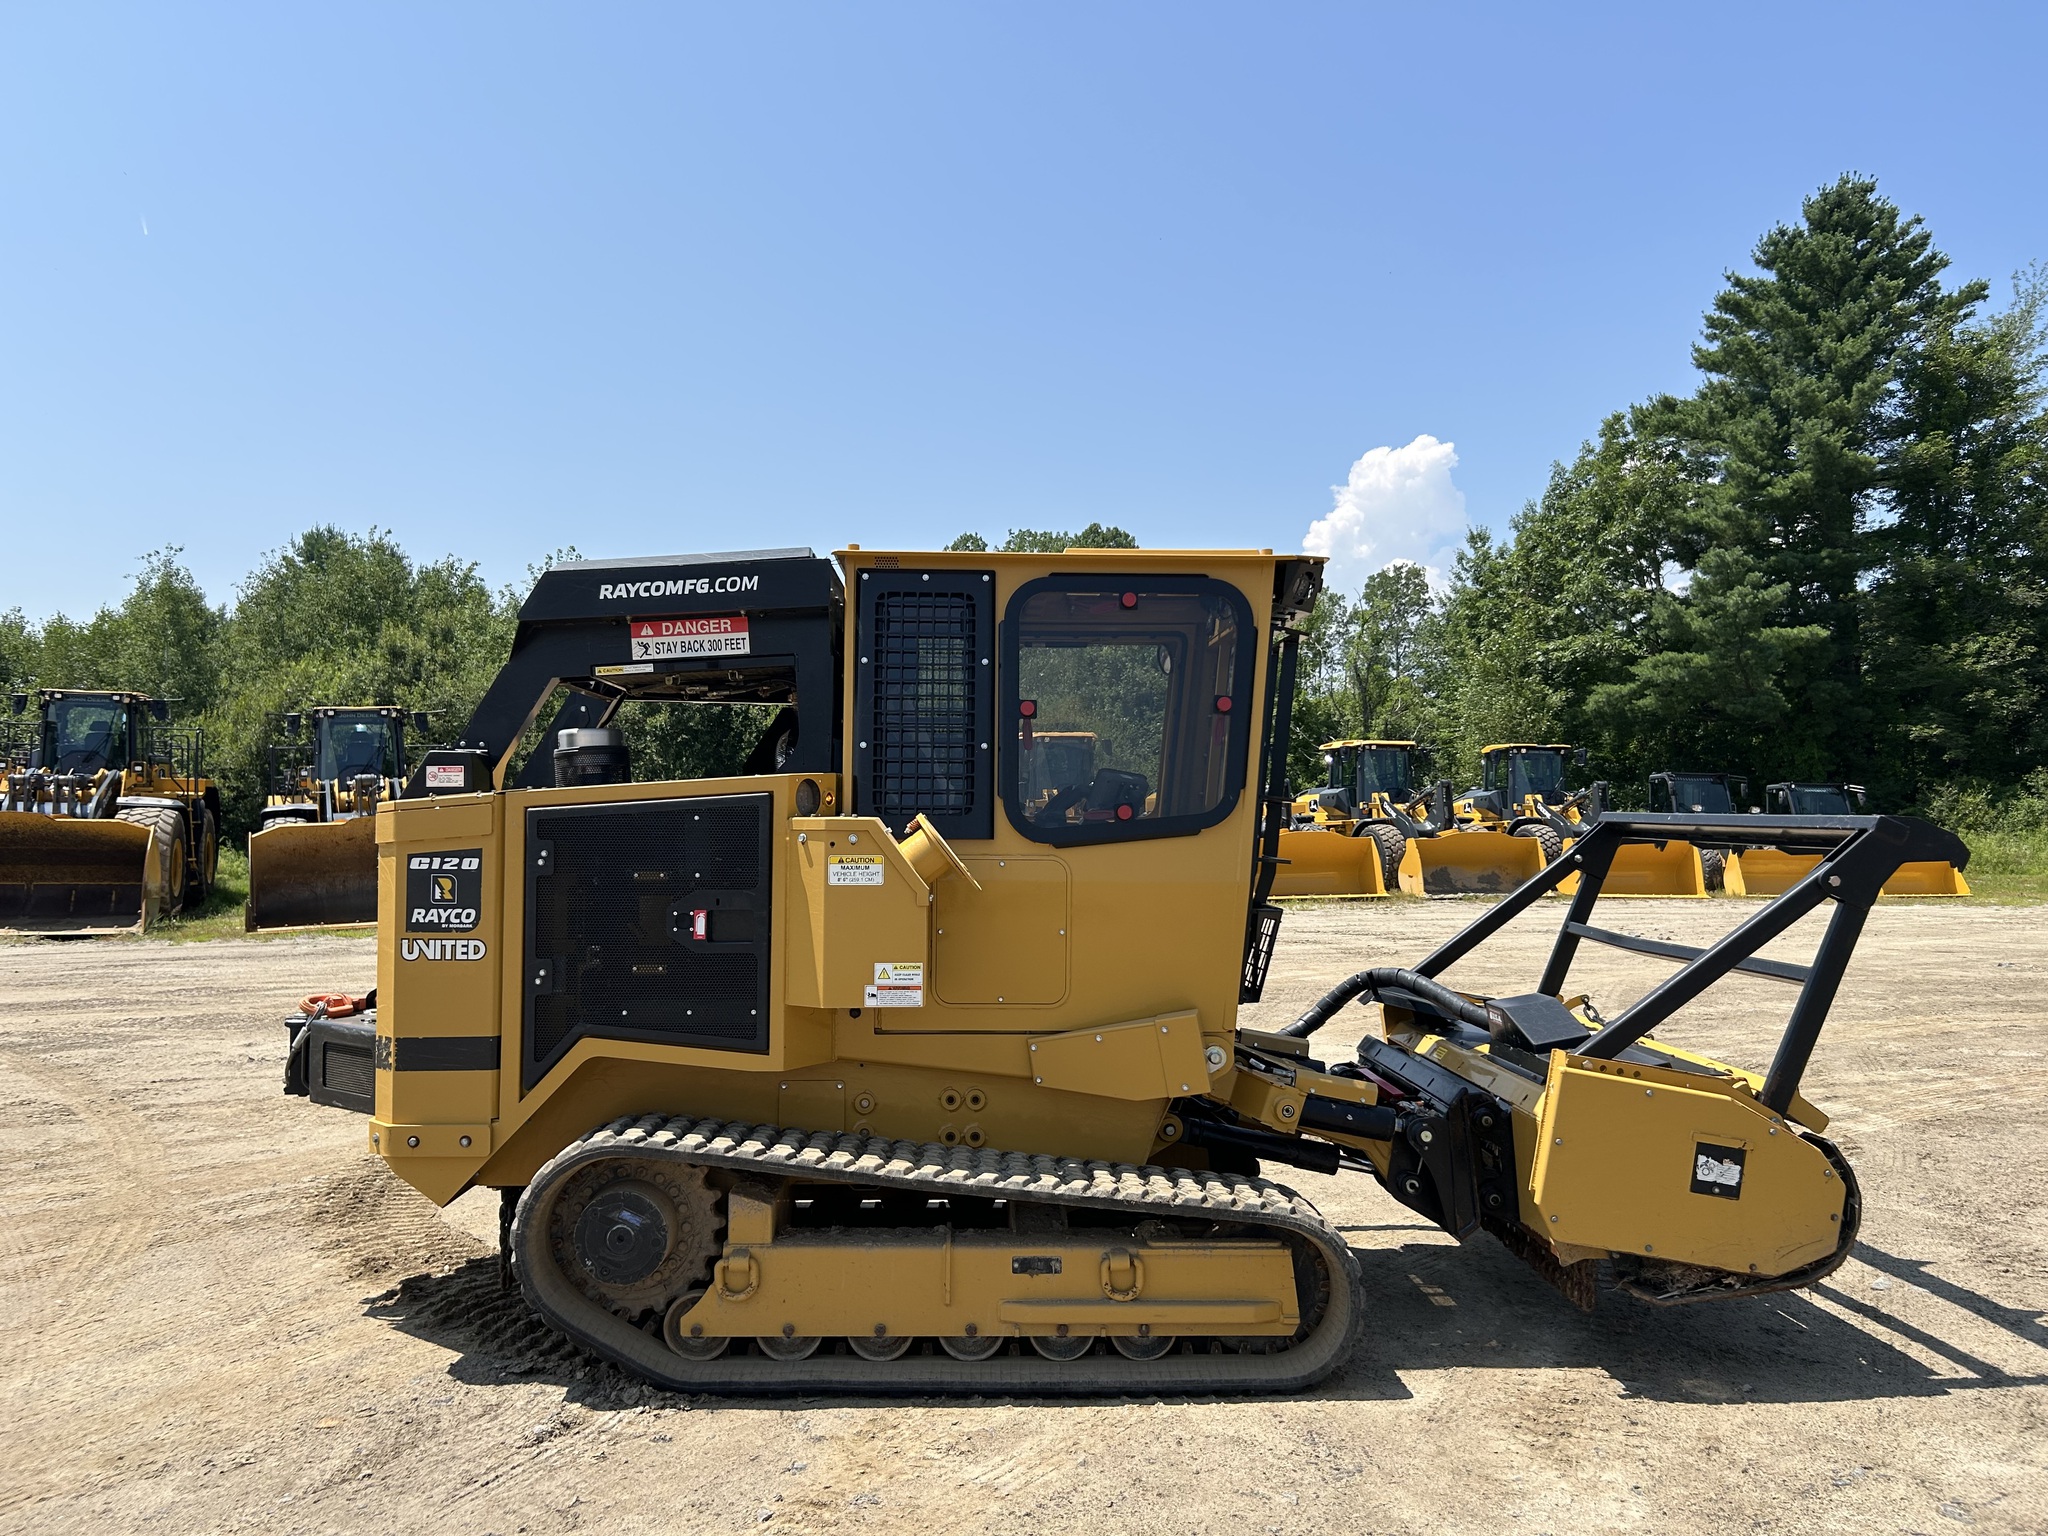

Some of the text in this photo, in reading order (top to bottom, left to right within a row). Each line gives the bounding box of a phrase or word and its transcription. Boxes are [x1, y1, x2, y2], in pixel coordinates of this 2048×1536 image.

[599, 575, 759, 600] RAYCOMFG.COM
[661, 619, 732, 635] DANGER
[655, 637, 747, 655] STAY BACK 300 FEET
[409, 857, 480, 870] C120
[411, 908, 477, 923] RAYCO
[401, 938, 487, 960] UNITED
